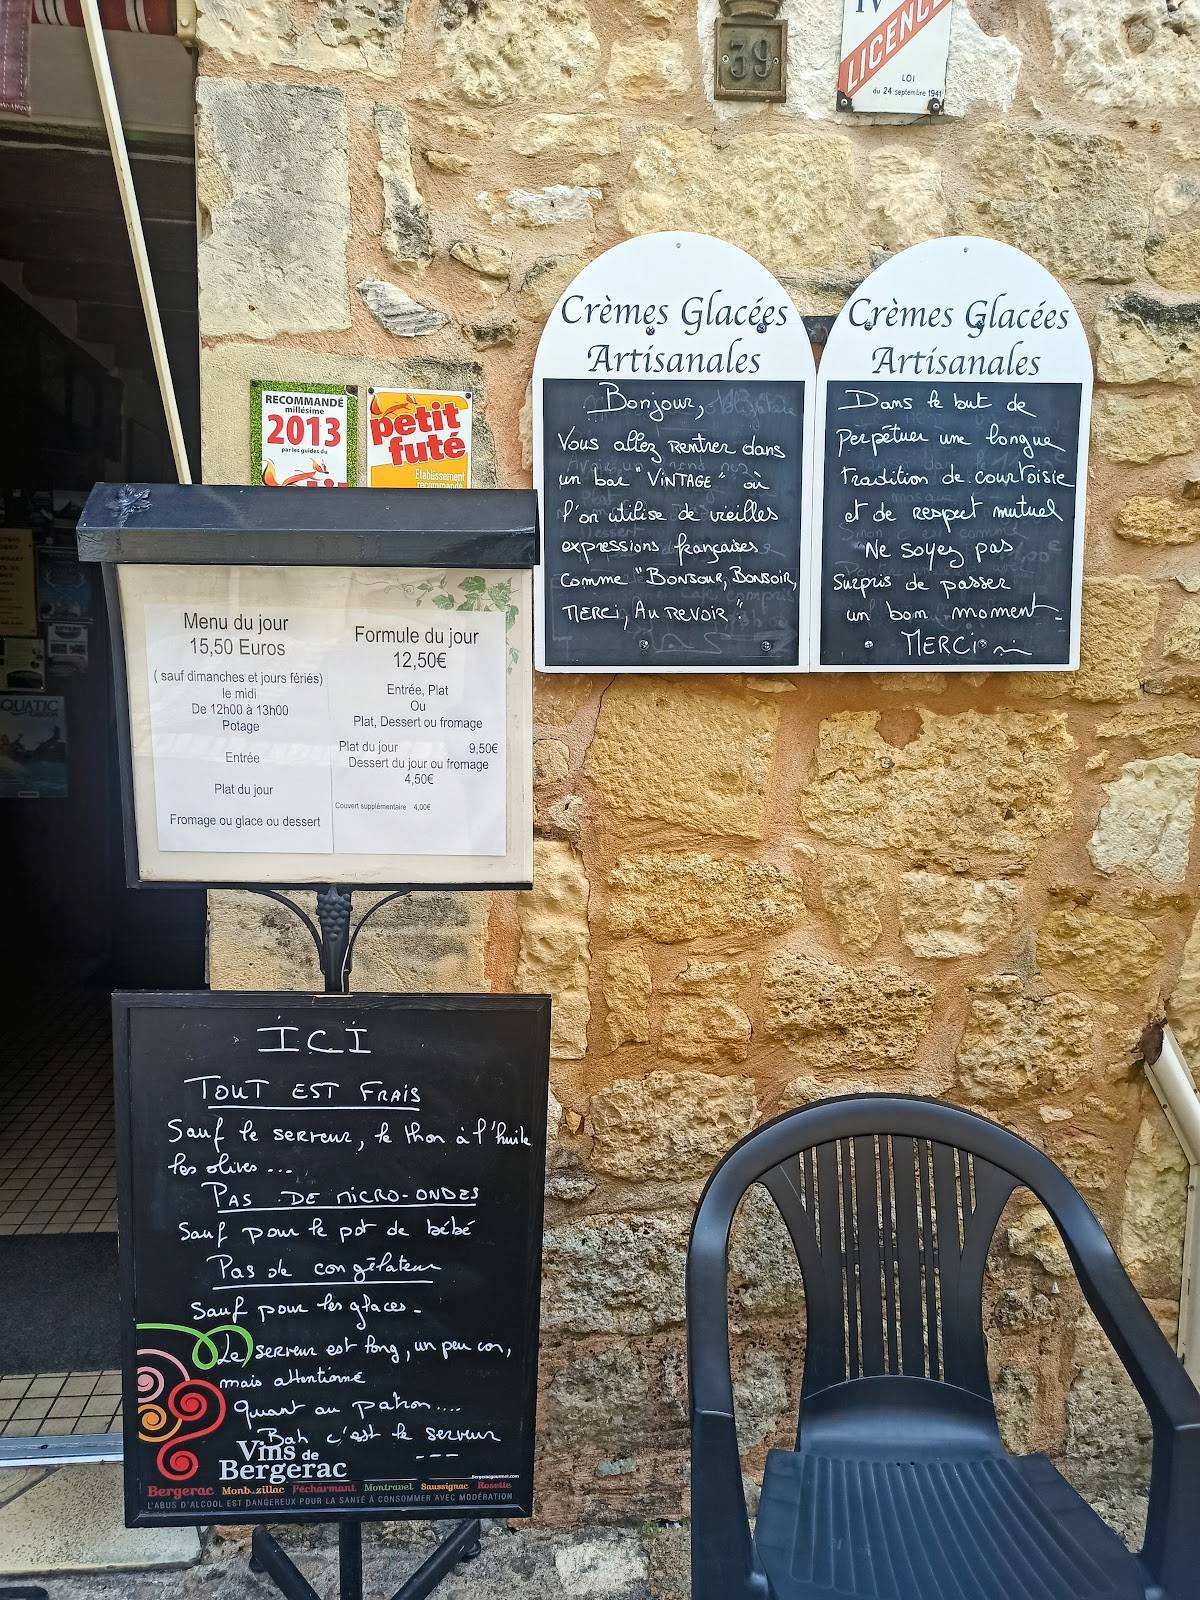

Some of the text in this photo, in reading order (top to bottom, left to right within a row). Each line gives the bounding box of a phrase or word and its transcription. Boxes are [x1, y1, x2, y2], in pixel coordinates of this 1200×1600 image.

[730, 38, 769, 80] 39
[901, 74, 915, 83] LOI
[872, 87, 943, 98] du 24 septembre 1941
[560, 289, 789, 336] Crèmes Glacées
[848, 292, 1070, 339] Crèmes Glacées
[587, 337, 761, 374] Artisanales
[871, 340, 1041, 376] Artisanales
[265, 394, 344, 408] RECOMMANDÉ
[284, 406, 325, 415] millésime
[837, 389, 1037, 418] Dans le but de
[266, 414, 341, 447] 2013
[370, 402, 461, 446] petit
[388, 432, 466, 466] futé
[557, 425, 786, 463] Vous allez dans
[939, 423, 1067, 459] une longue
[415, 468, 465, 481] Etablissement
[558, 470, 770, 490] un où
[941, 461, 1075, 488] de courtoisie
[608, 499, 779, 523] utilise de vieilles
[844, 499, 869, 523] et
[873, 502, 896, 522] de
[912, 495, 984, 533] respect
[992, 494, 1064, 522] mutuel
[561, 532, 759, 566] expressions françaises
[865, 539, 892, 559] Ne
[900, 544, 965, 571] soyez
[975, 539, 1014, 563] pas
[905, 572, 1012, 599] de passer
[846, 600, 929, 622] un bon
[184, 612, 289, 634] Menu du jour
[190, 637, 286, 657] 15,50 Euros
[354, 625, 479, 648] Formule du jour
[393, 651, 447, 671] 12,50€
[161, 669, 323, 687] sauf dimanches et jours fériés)
[222, 687, 257, 699] le midi
[387, 683, 449, 697] Entrée, Plat
[0, 698, 59, 713] QUATIC
[191, 702, 289, 716] De 12h00 à 13h00
[410, 699, 426, 712] Ou
[222, 719, 260, 734] Potage
[353, 715, 483, 731] Plat, Dessert ou fromage
[225, 751, 260, 763] Entrée
[339, 740, 499, 755] Plat du jour 9,50€
[348, 756, 489, 772] Dessert du jour ou fromage
[214, 783, 273, 798] Plat du jour
[404, 773, 434, 786] 4,50€
[335, 802, 407, 811] Couvert supplémentaire
[170, 813, 321, 829] Fromage ou glace ou dessert
[257, 1026, 371, 1054] ICI
[184, 1075, 340, 1100] TOUT EST
[168, 1116, 445, 1153] Sauf le le thon
[168, 1152, 197, 1175] les
[201, 1181, 321, 1208] PAS DE
[178, 1215, 476, 1248] Sauf pour le pot de bébé
[206, 1254, 255, 1279] Pas
[190, 1292, 343, 1323] Sauf pour les
[255, 1336, 472, 1360] serveur est un peu
[219, 1374, 262, 1389] mais
[315, 1404, 341, 1415] au
[391, 1422, 502, 1441] le serveur
[236, 1439, 319, 1462] Vins de
[218, 1459, 347, 1484] Bergerac
[147, 1485, 215, 1499] Bergerac
[222, 1484, 286, 1496] Monbzillac
[364, 1481, 414, 1492] Montravel
[420, 1482, 469, 1495] Saussignac
[147, 1491, 513, 1509] L'ABUS D'ALCOOL EST DANGEREUX POUR LA SANTÉ CONSOMMER AVEC MODÉRATION
